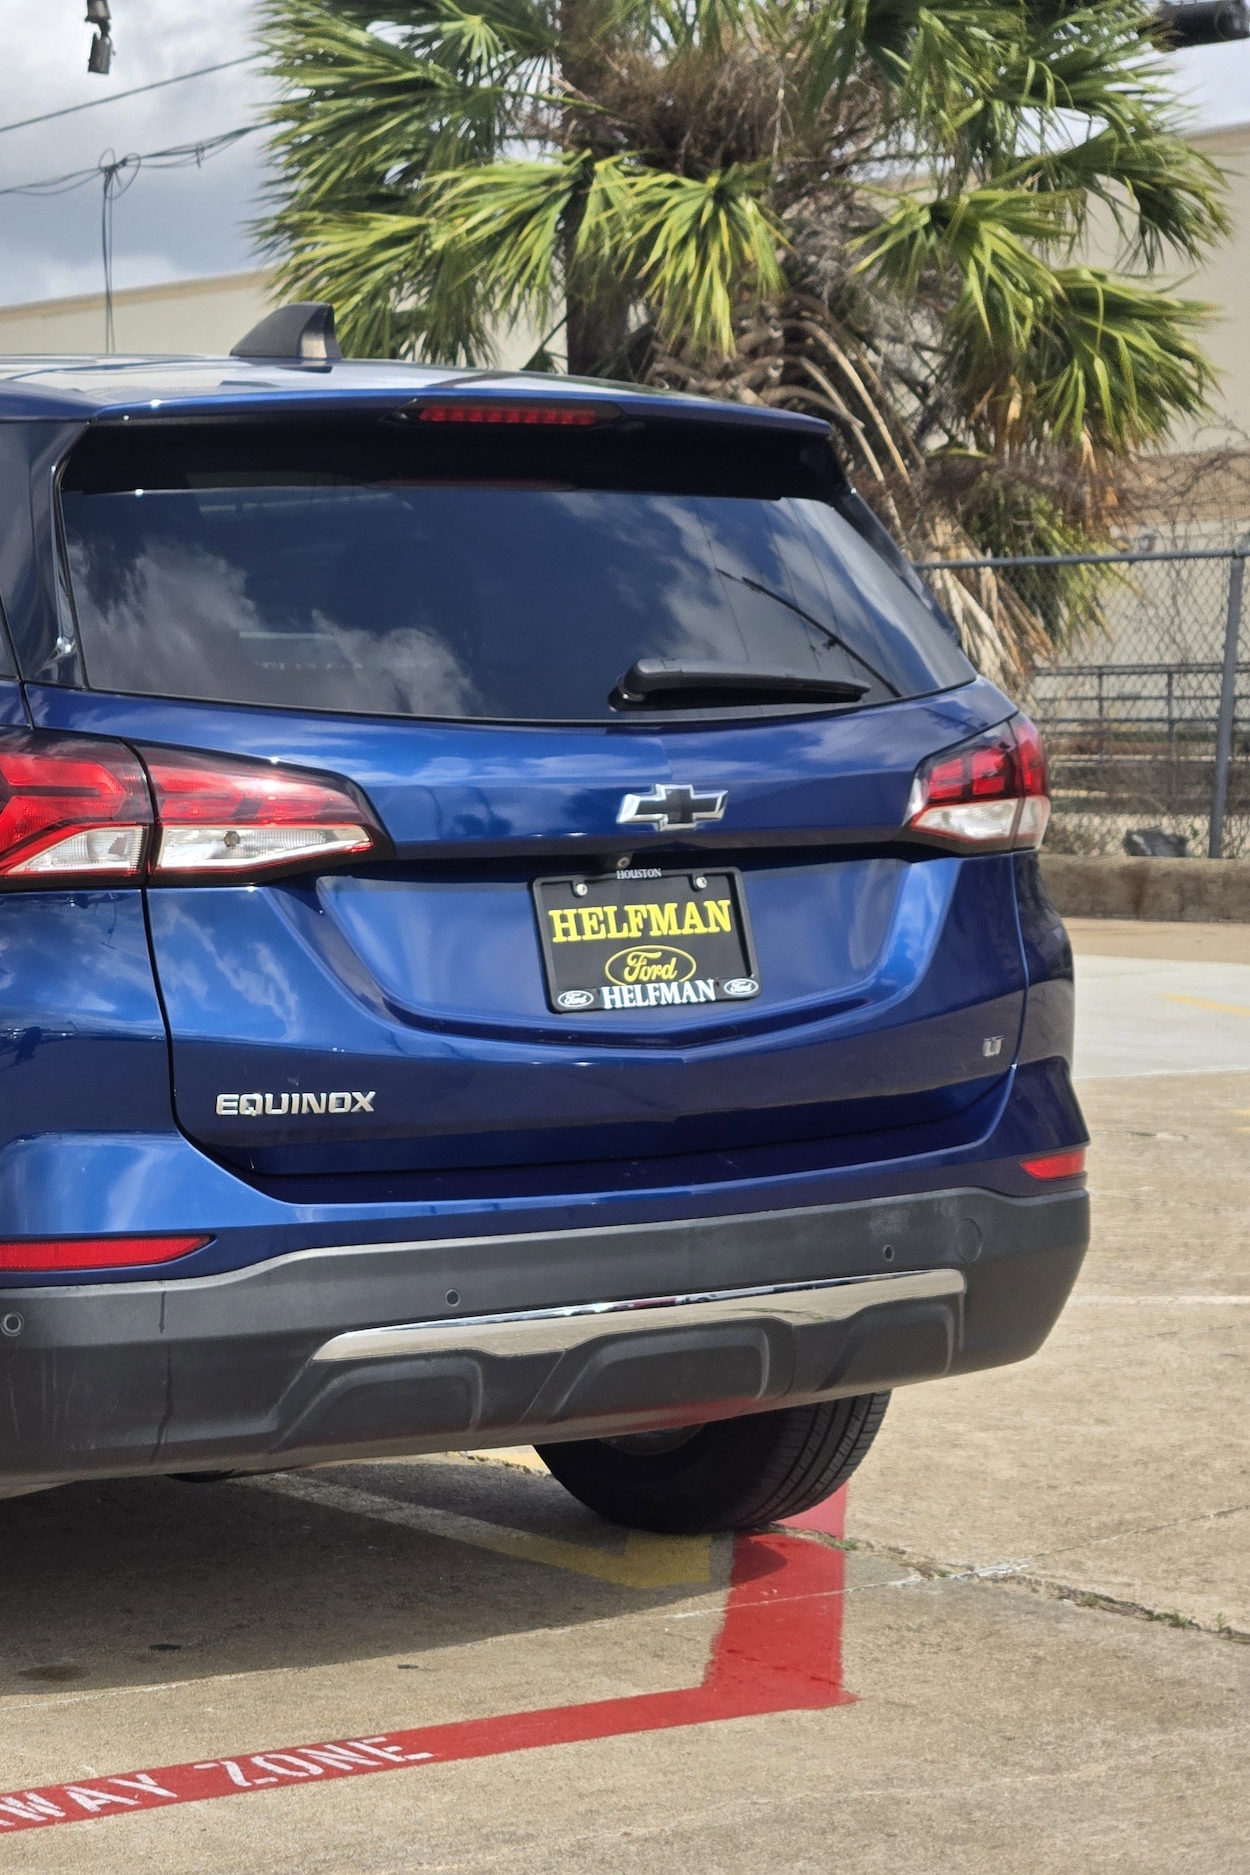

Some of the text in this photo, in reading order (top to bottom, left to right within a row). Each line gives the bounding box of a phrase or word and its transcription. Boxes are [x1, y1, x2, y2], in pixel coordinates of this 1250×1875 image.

[616, 868, 662, 880] HOUSTON
[548, 900, 732, 943] HELFMAN
[623, 951, 678, 982] Ford
[600, 979, 717, 1010] HELFMAN
[215, 1090, 377, 1117] EQUINOX
[193, 1737, 434, 1787] ZONE
